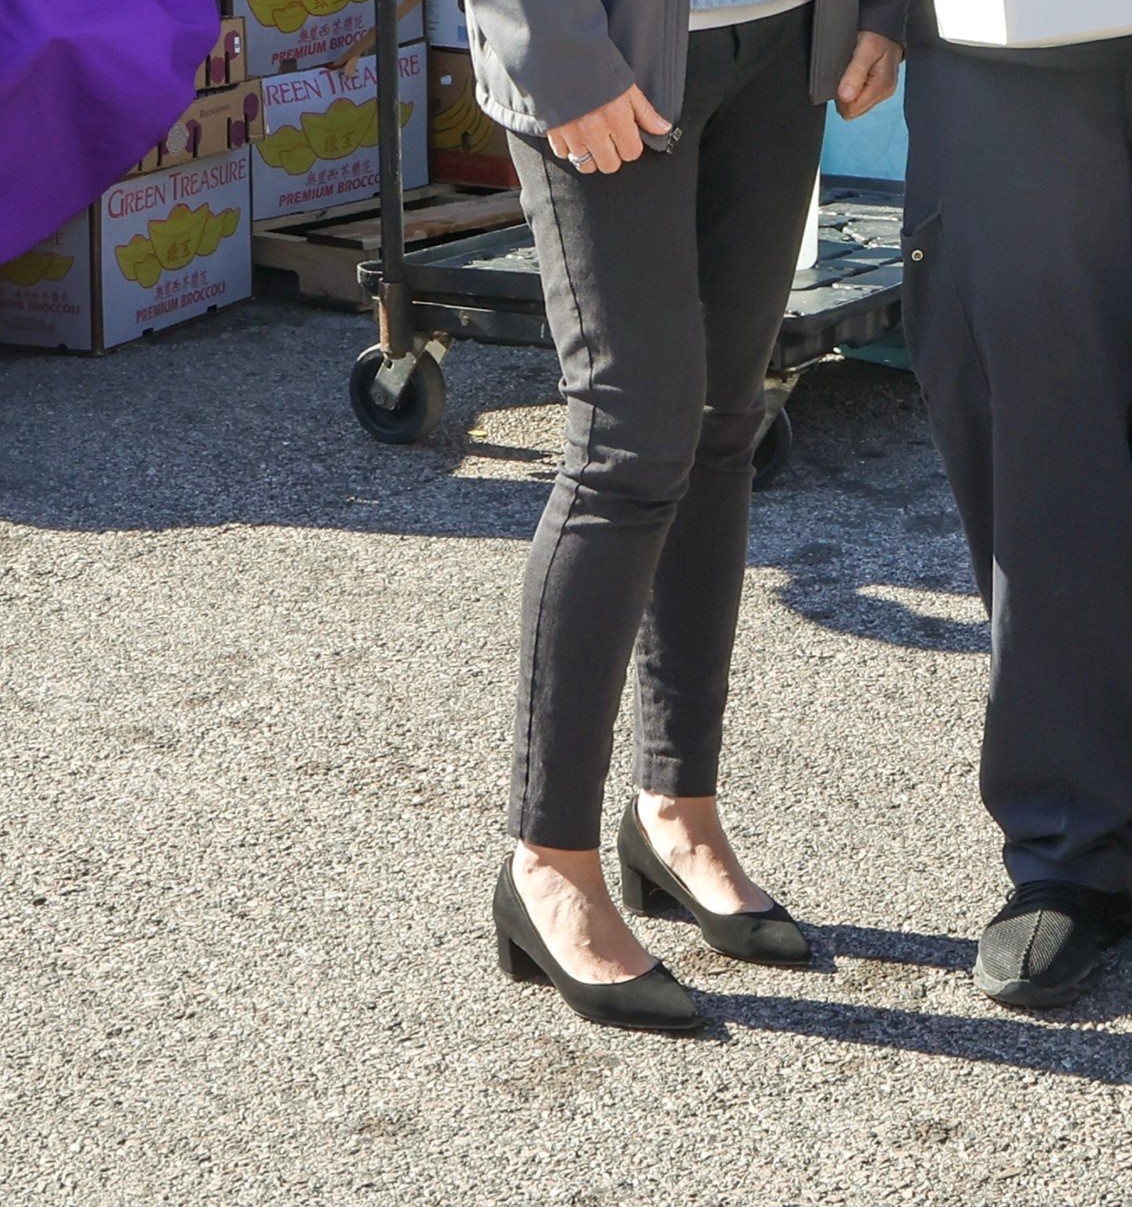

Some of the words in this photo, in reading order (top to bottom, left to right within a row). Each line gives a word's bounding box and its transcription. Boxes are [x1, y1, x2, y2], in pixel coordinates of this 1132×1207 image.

[271, 38, 327, 64] PREMIUM
[330, 29, 368, 49] BROCC
[265, 78, 322, 106] REEN
[108, 182, 166, 219] GREEN
[169, 158, 247, 200] TREASURE
[279, 185, 334, 207] PREMIUM
[337, 173, 381, 194] BROCCO
[136, 296, 179, 324] PREMIUM
[181, 281, 226, 307] BROCCOLI
